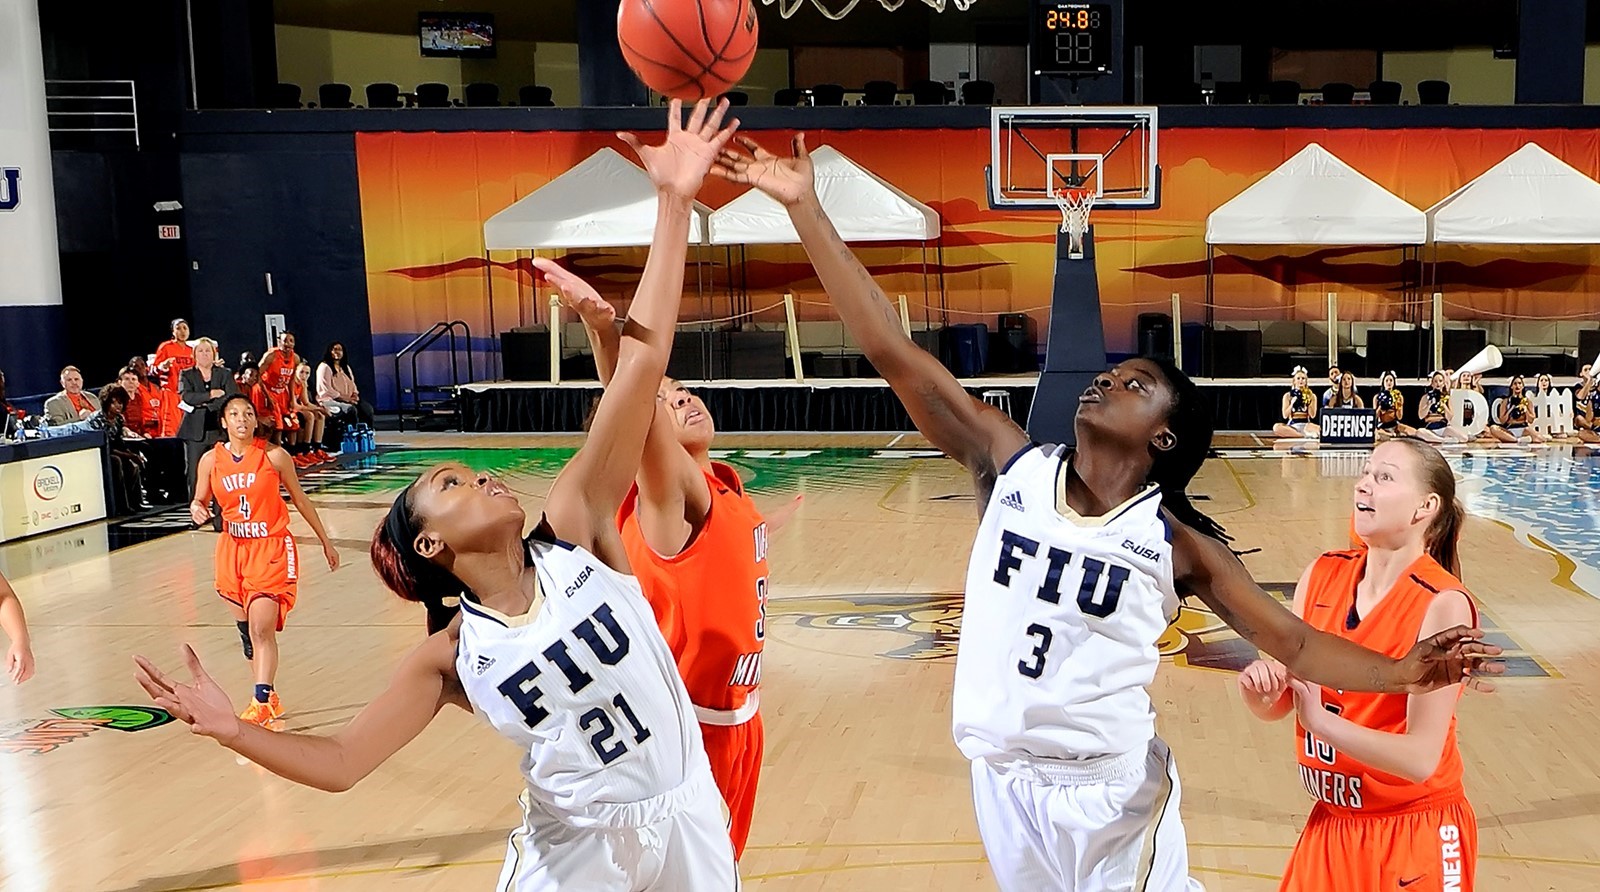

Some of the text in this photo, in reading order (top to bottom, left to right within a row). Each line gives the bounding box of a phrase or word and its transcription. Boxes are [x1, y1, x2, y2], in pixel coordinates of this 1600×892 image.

[1047, 10, 1088, 29] 24.8
[161, 226, 177, 238] EXIT
[1322, 414, 1374, 438] DEFENSE
[222, 472, 256, 492] UTEP
[239, 494, 251, 520] 4
[1000, 498, 1025, 512] adidas
[993, 529, 1131, 619] FIU
[1018, 622, 1053, 680] 3
[497, 602, 630, 729] FIU
[578, 692, 651, 766] 21
[1439, 824, 1461, 892] NERS
